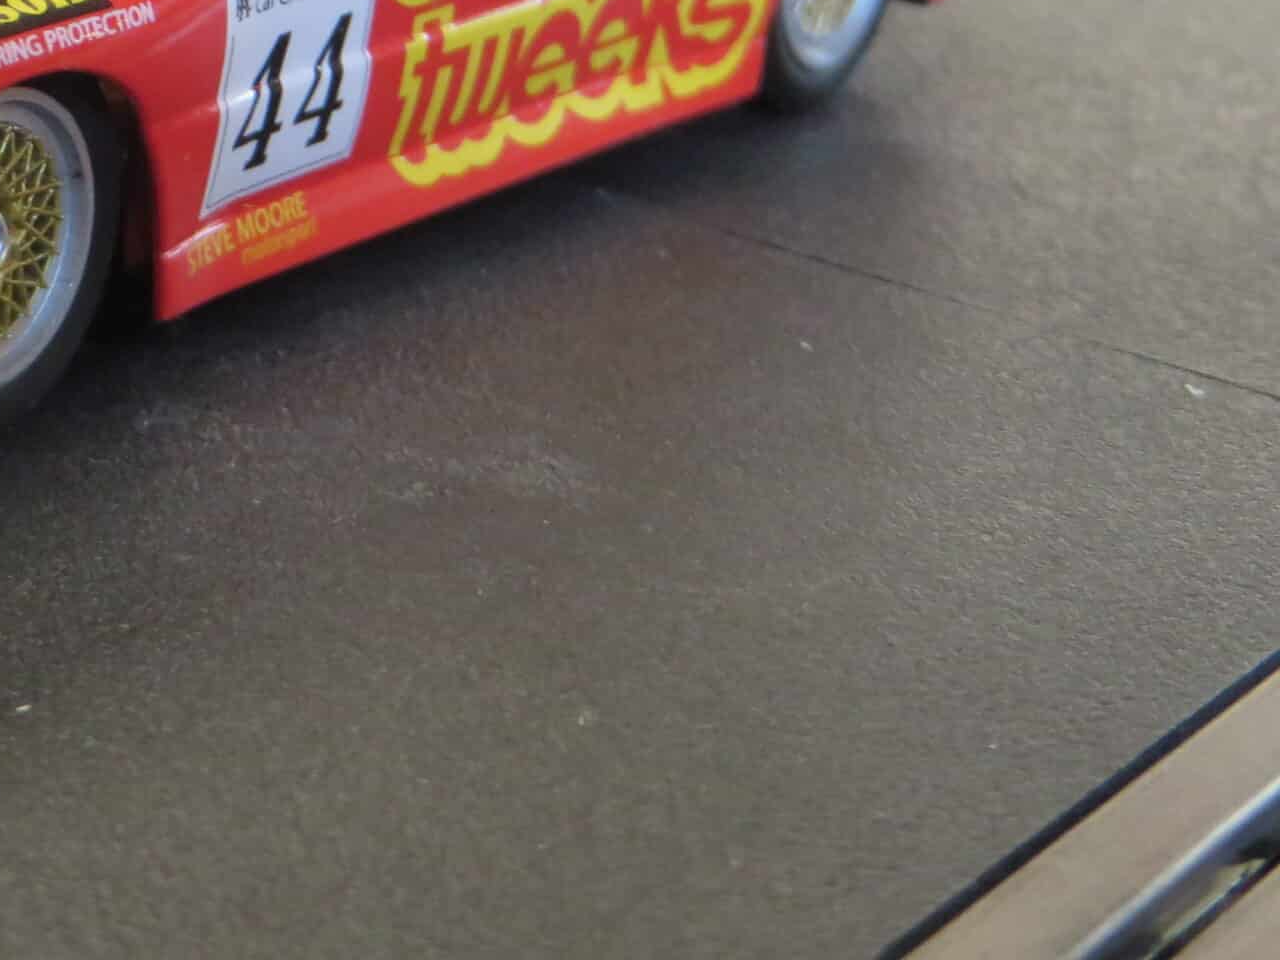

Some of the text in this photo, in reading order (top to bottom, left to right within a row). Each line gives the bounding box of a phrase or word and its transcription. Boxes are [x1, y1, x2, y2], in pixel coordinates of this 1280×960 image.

[44, 0, 156, 54] PROTECTION
[231, 11, 353, 172] 44
[186, 223, 237, 278] STEVE
[236, 191, 308, 245] MOORE
